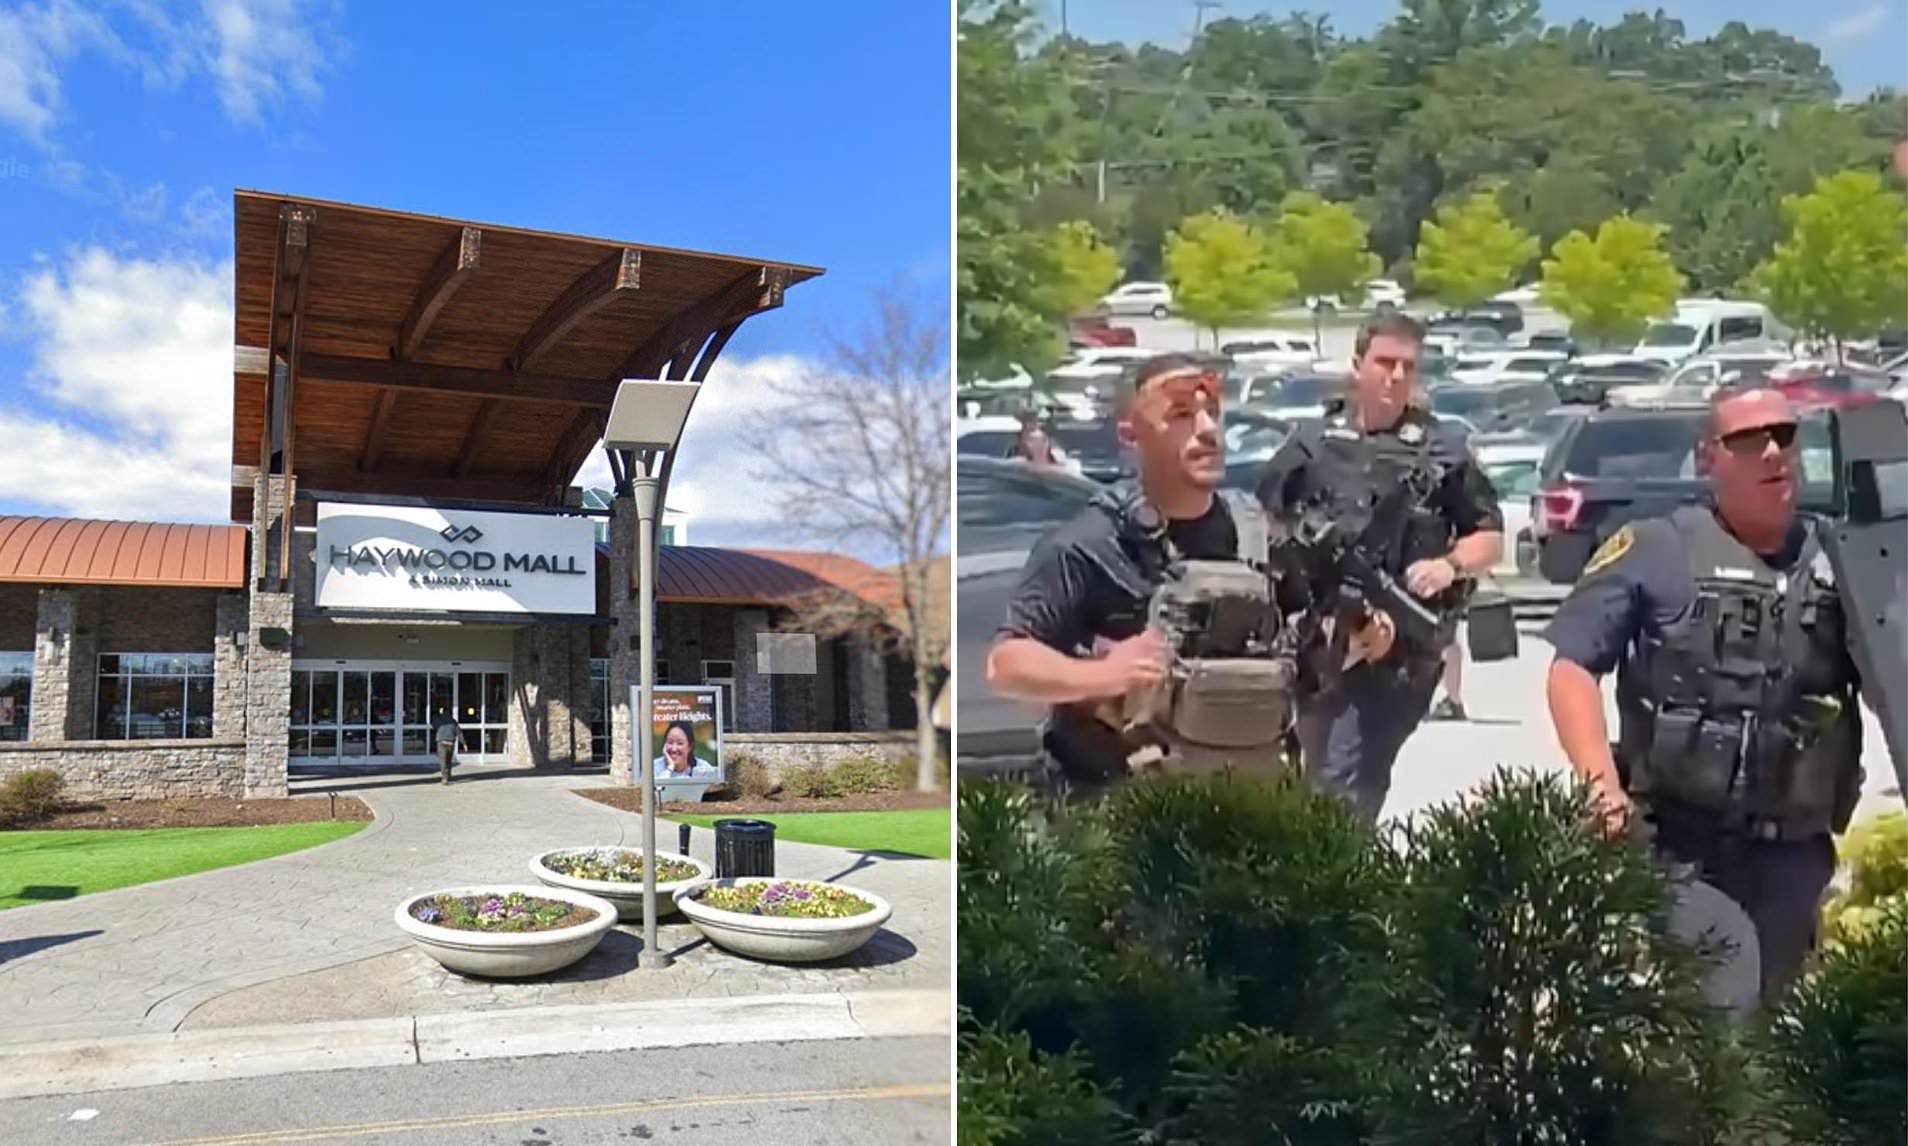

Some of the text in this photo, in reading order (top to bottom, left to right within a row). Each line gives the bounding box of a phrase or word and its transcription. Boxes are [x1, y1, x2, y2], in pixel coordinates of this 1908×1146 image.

[329, 544, 587, 575] HAYWOOD MALL
[422, 575, 470, 586] SIMON
[474, 577, 512, 588] MALL
[653, 712, 678, 721] reater
